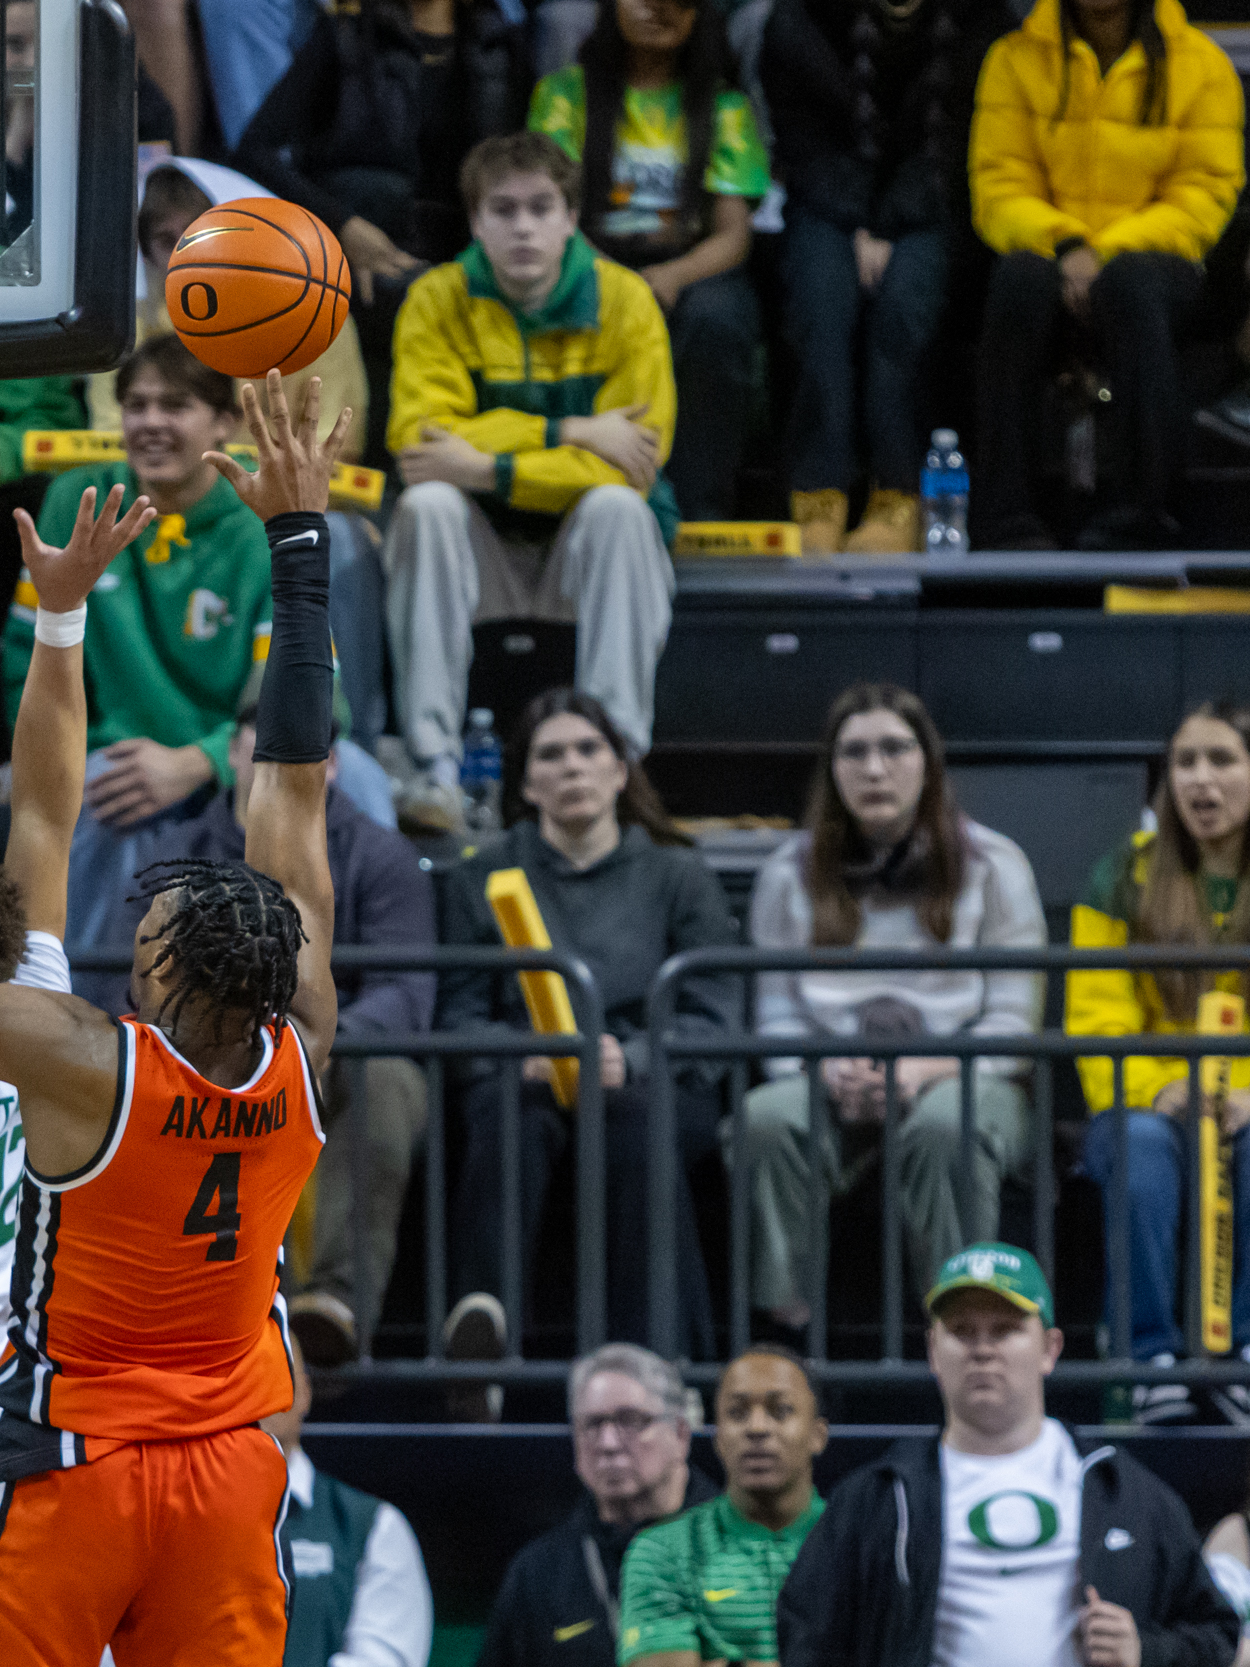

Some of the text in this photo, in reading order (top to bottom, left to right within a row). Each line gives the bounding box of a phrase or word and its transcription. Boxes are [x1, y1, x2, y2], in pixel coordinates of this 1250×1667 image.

[159, 1087, 287, 1139] AKANNO
[182, 1152, 242, 1262] 4
[967, 1488, 1059, 1553] O
